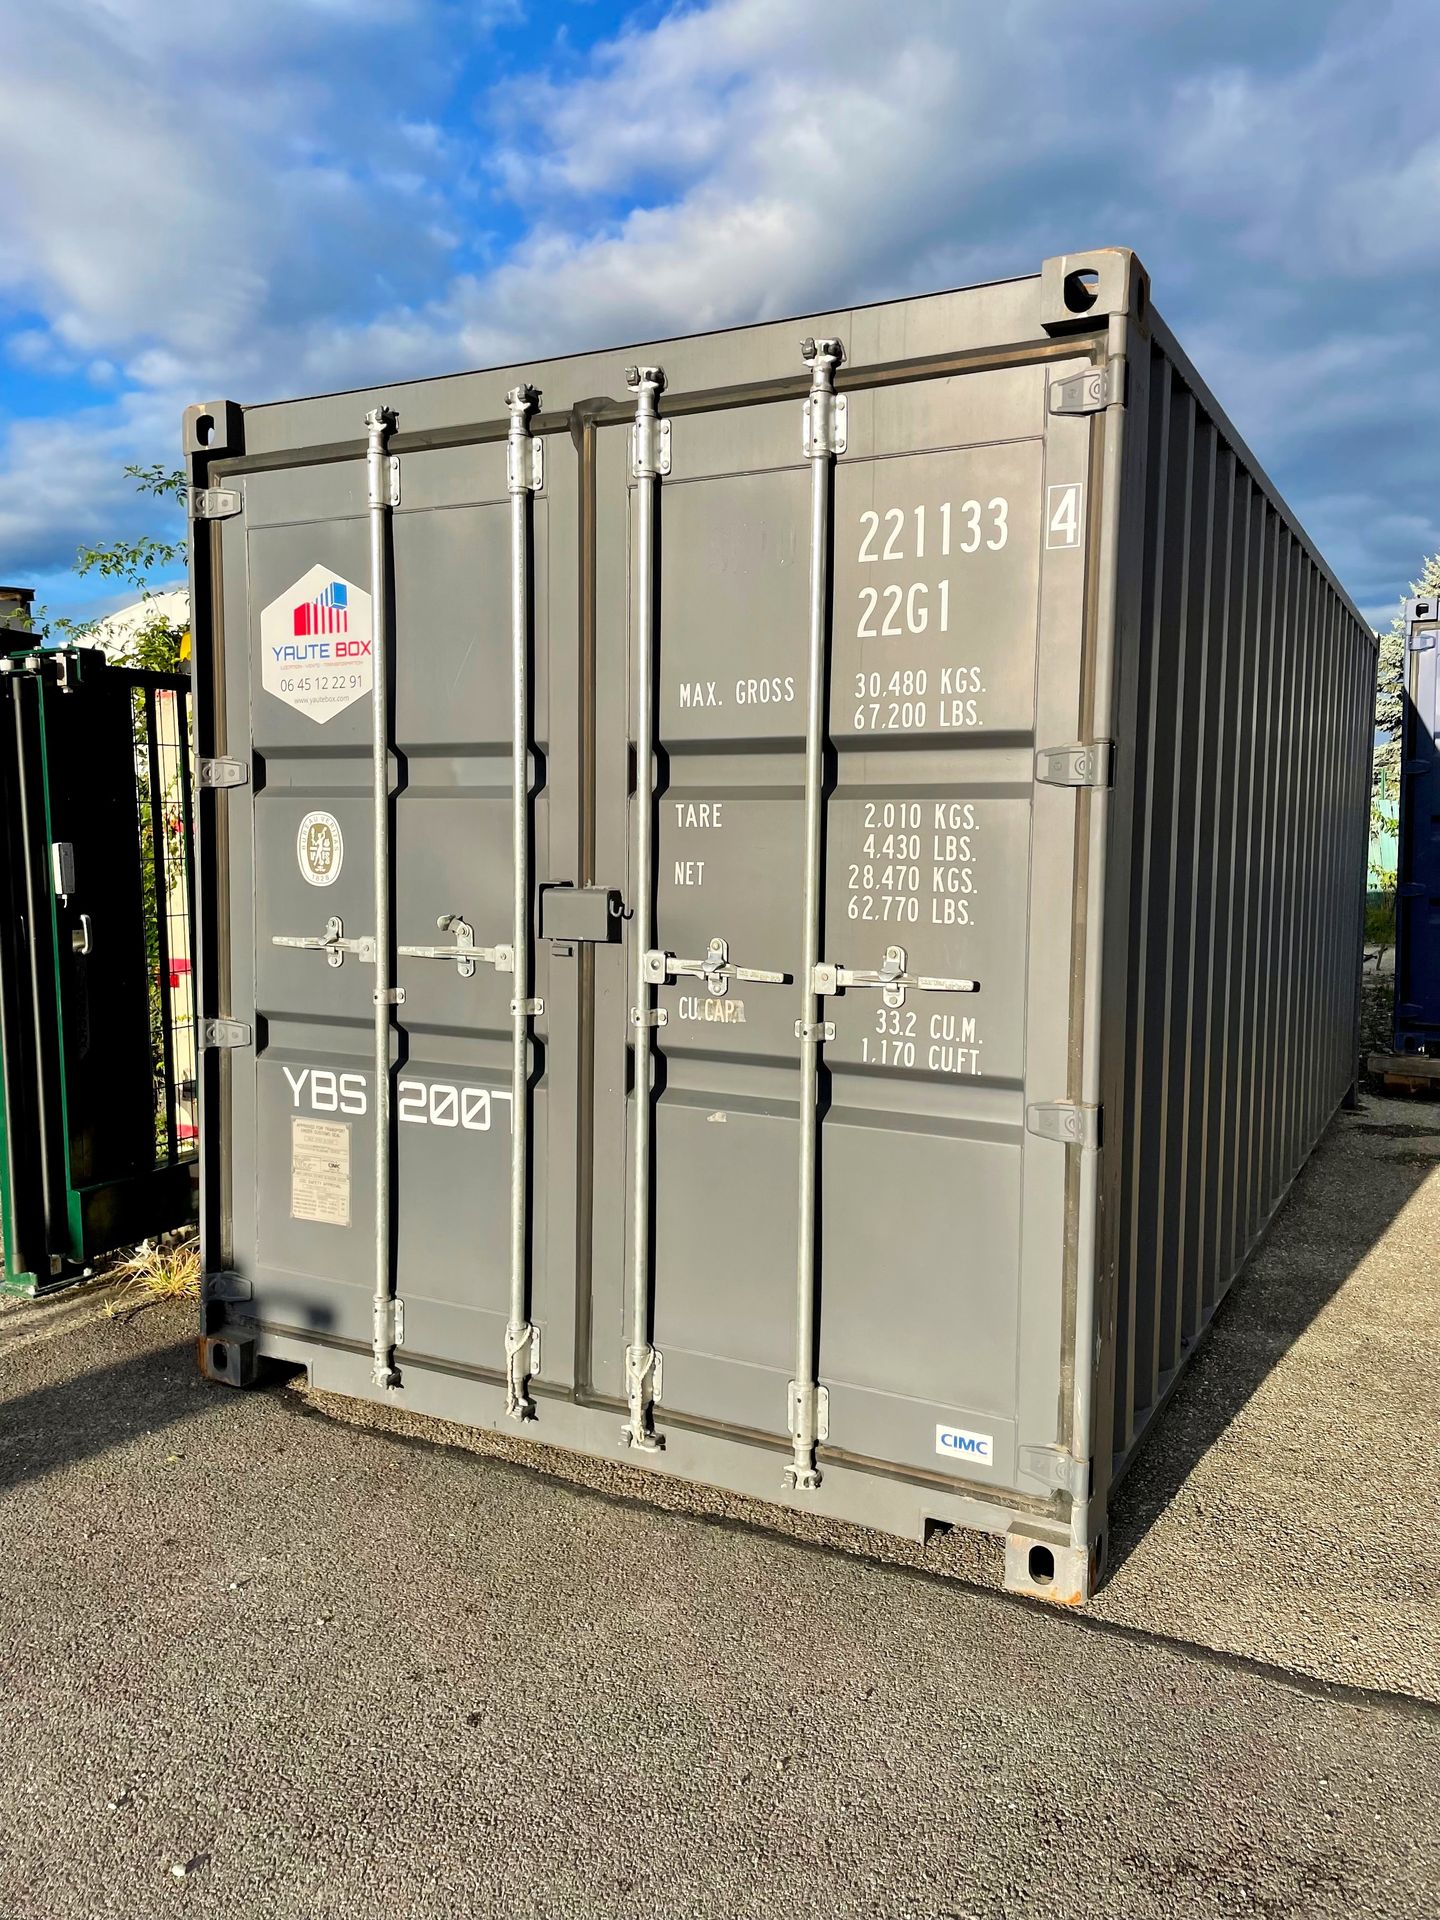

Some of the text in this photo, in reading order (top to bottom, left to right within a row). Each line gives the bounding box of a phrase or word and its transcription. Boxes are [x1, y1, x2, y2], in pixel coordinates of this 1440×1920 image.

[858, 497, 1009, 563] 221133
[1051, 489, 1077, 544] 4
[857, 580, 949, 638] 22G1
[272, 640, 371, 661] YAUTE BOX
[281, 675, 362, 692] 06 45 12 22 91
[679, 677, 794, 707] MAX. GROSS
[941, 667, 986, 694] KGS.
[294, 695, 349, 704] www.yautebox.com
[940, 700, 983, 727] LBS.
[676, 804, 722, 828] TARE
[935, 804, 979, 830] KGS.
[934, 835, 976, 862] LBS.
[675, 862, 704, 886] NET
[933, 867, 978, 894] KGS.
[932, 897, 974, 925] LBS.
[875, 1009, 983, 1044] 33.2 CU.M.
[282, 1067, 367, 1115] YBS
[941, 1434, 988, 1455] CIMC
